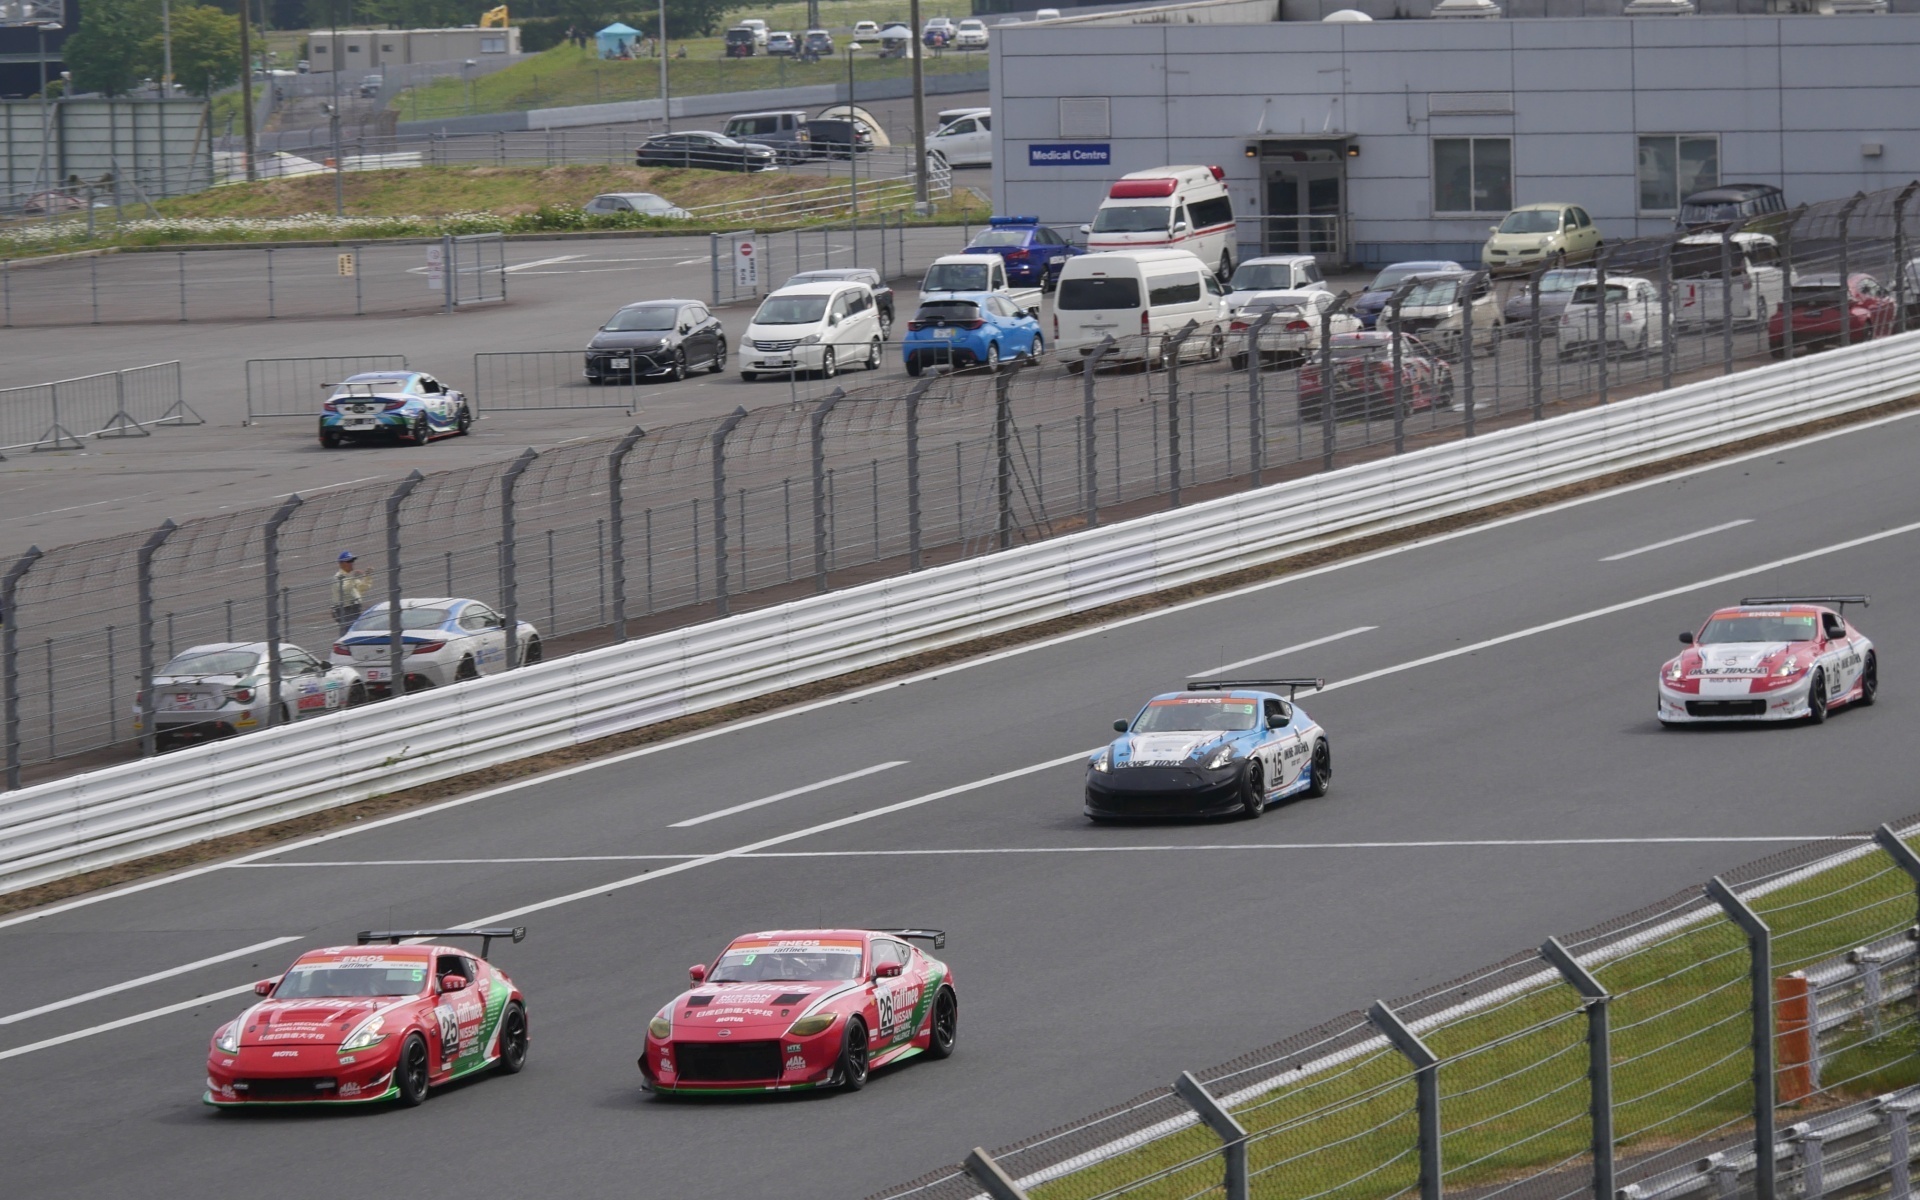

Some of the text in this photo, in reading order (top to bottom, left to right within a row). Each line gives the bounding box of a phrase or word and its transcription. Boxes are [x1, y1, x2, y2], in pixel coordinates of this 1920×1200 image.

[1032, 150, 1107, 160] Medical Centre
[1272, 751, 1283, 777] 15
[880, 995, 893, 1027] 26
[893, 1008, 913, 1025] NISSAN
[442, 1013, 458, 1046] 25
